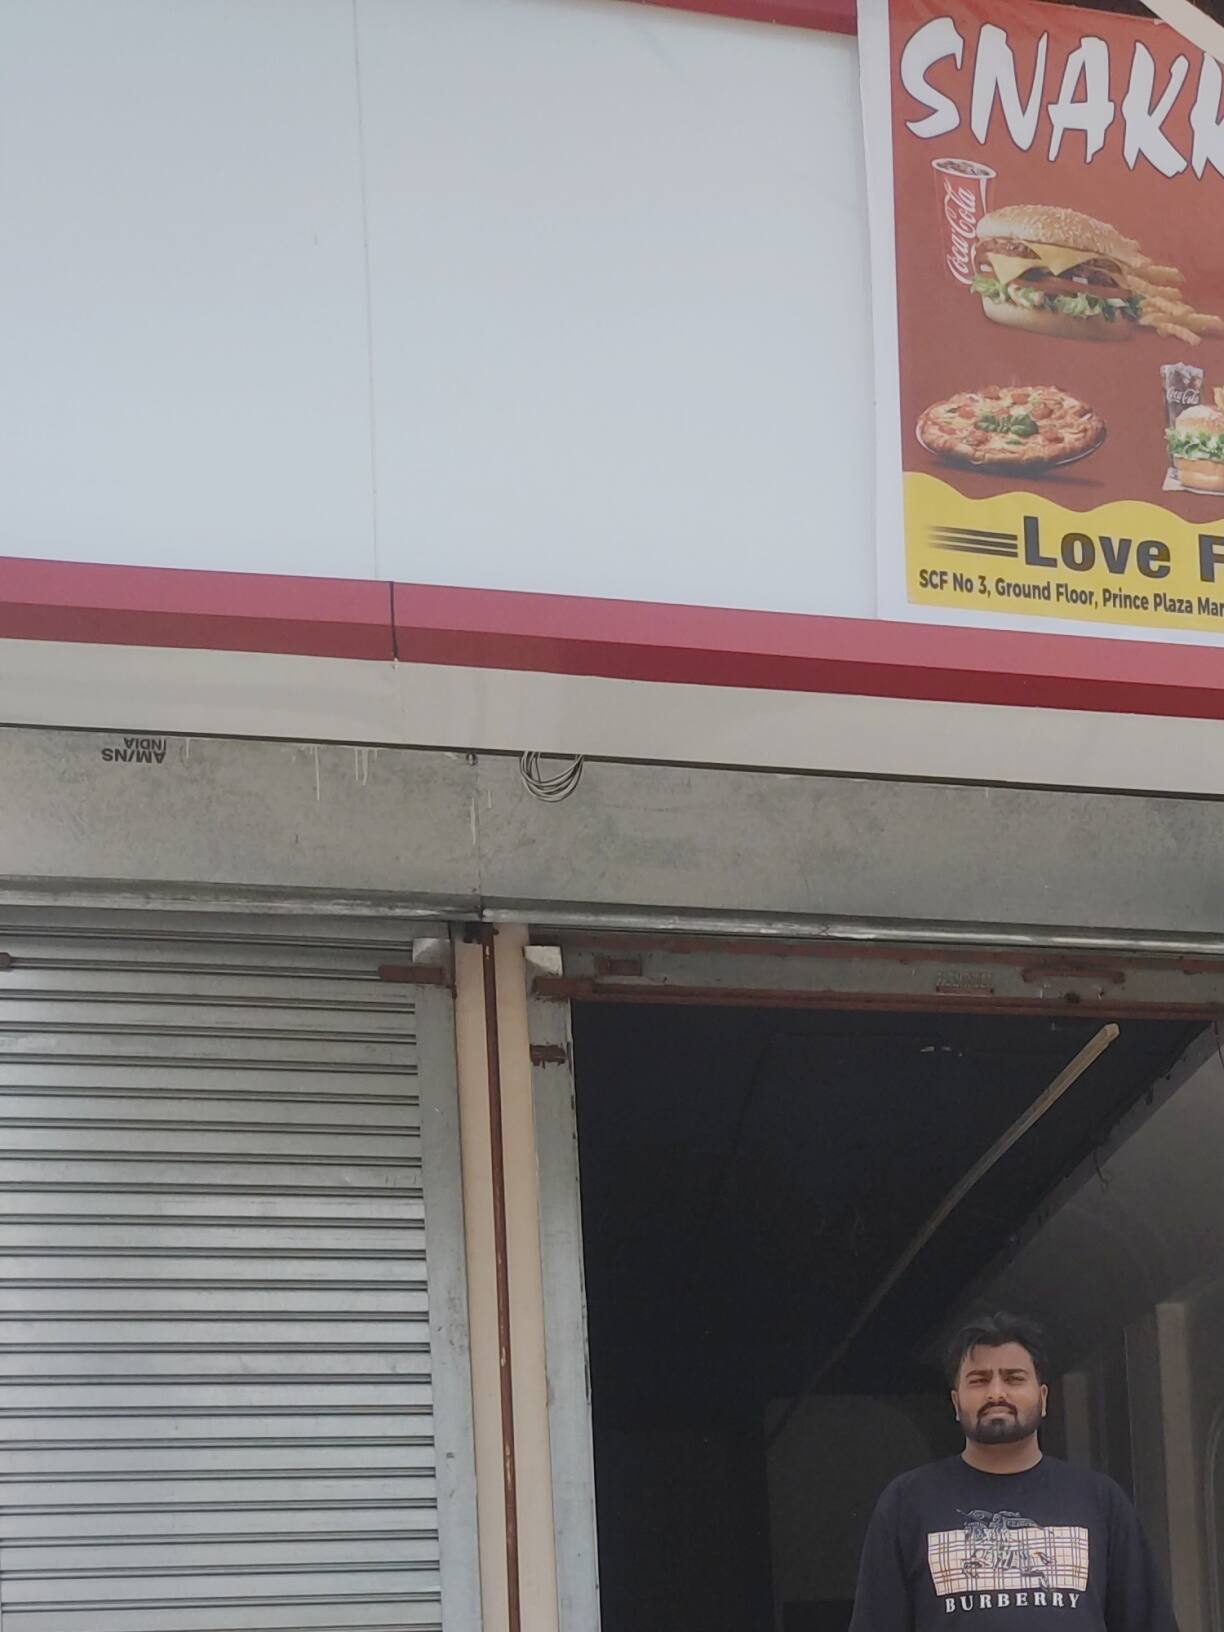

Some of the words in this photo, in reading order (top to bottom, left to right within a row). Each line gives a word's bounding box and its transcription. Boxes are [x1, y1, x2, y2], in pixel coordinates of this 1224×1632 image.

[1023, 515, 1171, 579] Love
[919, 568, 949, 590] SCF
[953, 572, 974, 594] No
[978, 575, 991, 598] 3,
[995, 577, 1051, 601] Ground
[1056, 583, 1099, 609] Floor,
[1102, 587, 1149, 611] Prince
[1154, 592, 1193, 614] Plaza
[101, 747, 166, 764] AM/NS
[123, 736, 167, 751] INDIA
[944, 1590, 1081, 1614] BURBERRY
